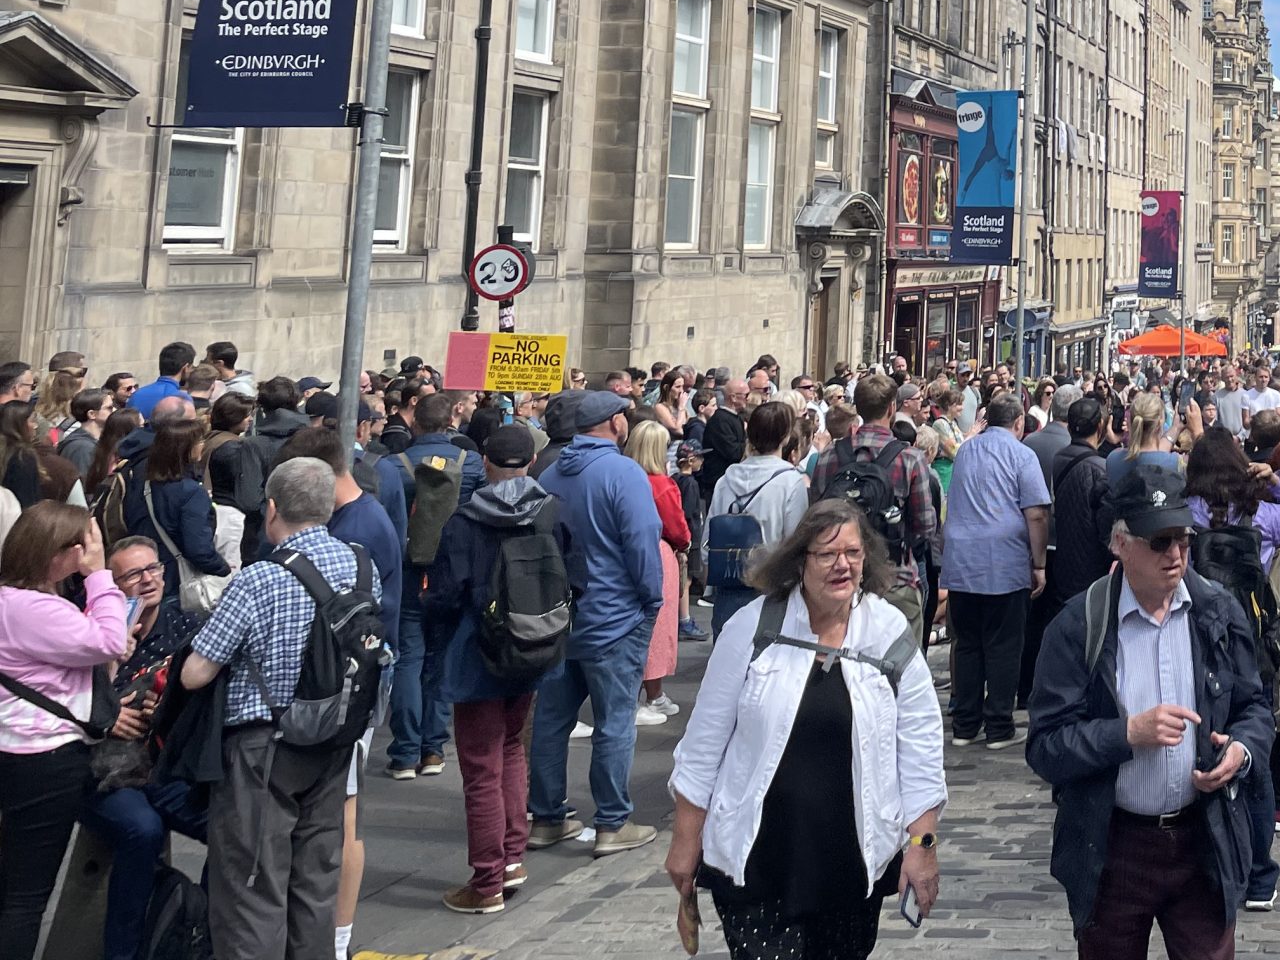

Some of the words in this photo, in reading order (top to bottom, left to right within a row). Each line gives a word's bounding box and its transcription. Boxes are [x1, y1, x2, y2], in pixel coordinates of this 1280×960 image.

[218, 23, 241, 36] The
[244, 22, 289, 36] Perfect
[292, 22, 328, 38] Stage
[958, 110, 983, 123] fringe
[963, 214, 1005, 227] Scotland
[1145, 267, 1173, 275] Scotland
[516, 340, 540, 353] NO
[492, 351, 561, 366] PARKING
[488, 371, 496, 379] TO
[490, 364, 506, 372] FROM
[531, 366, 549, 374] FRIDAY
